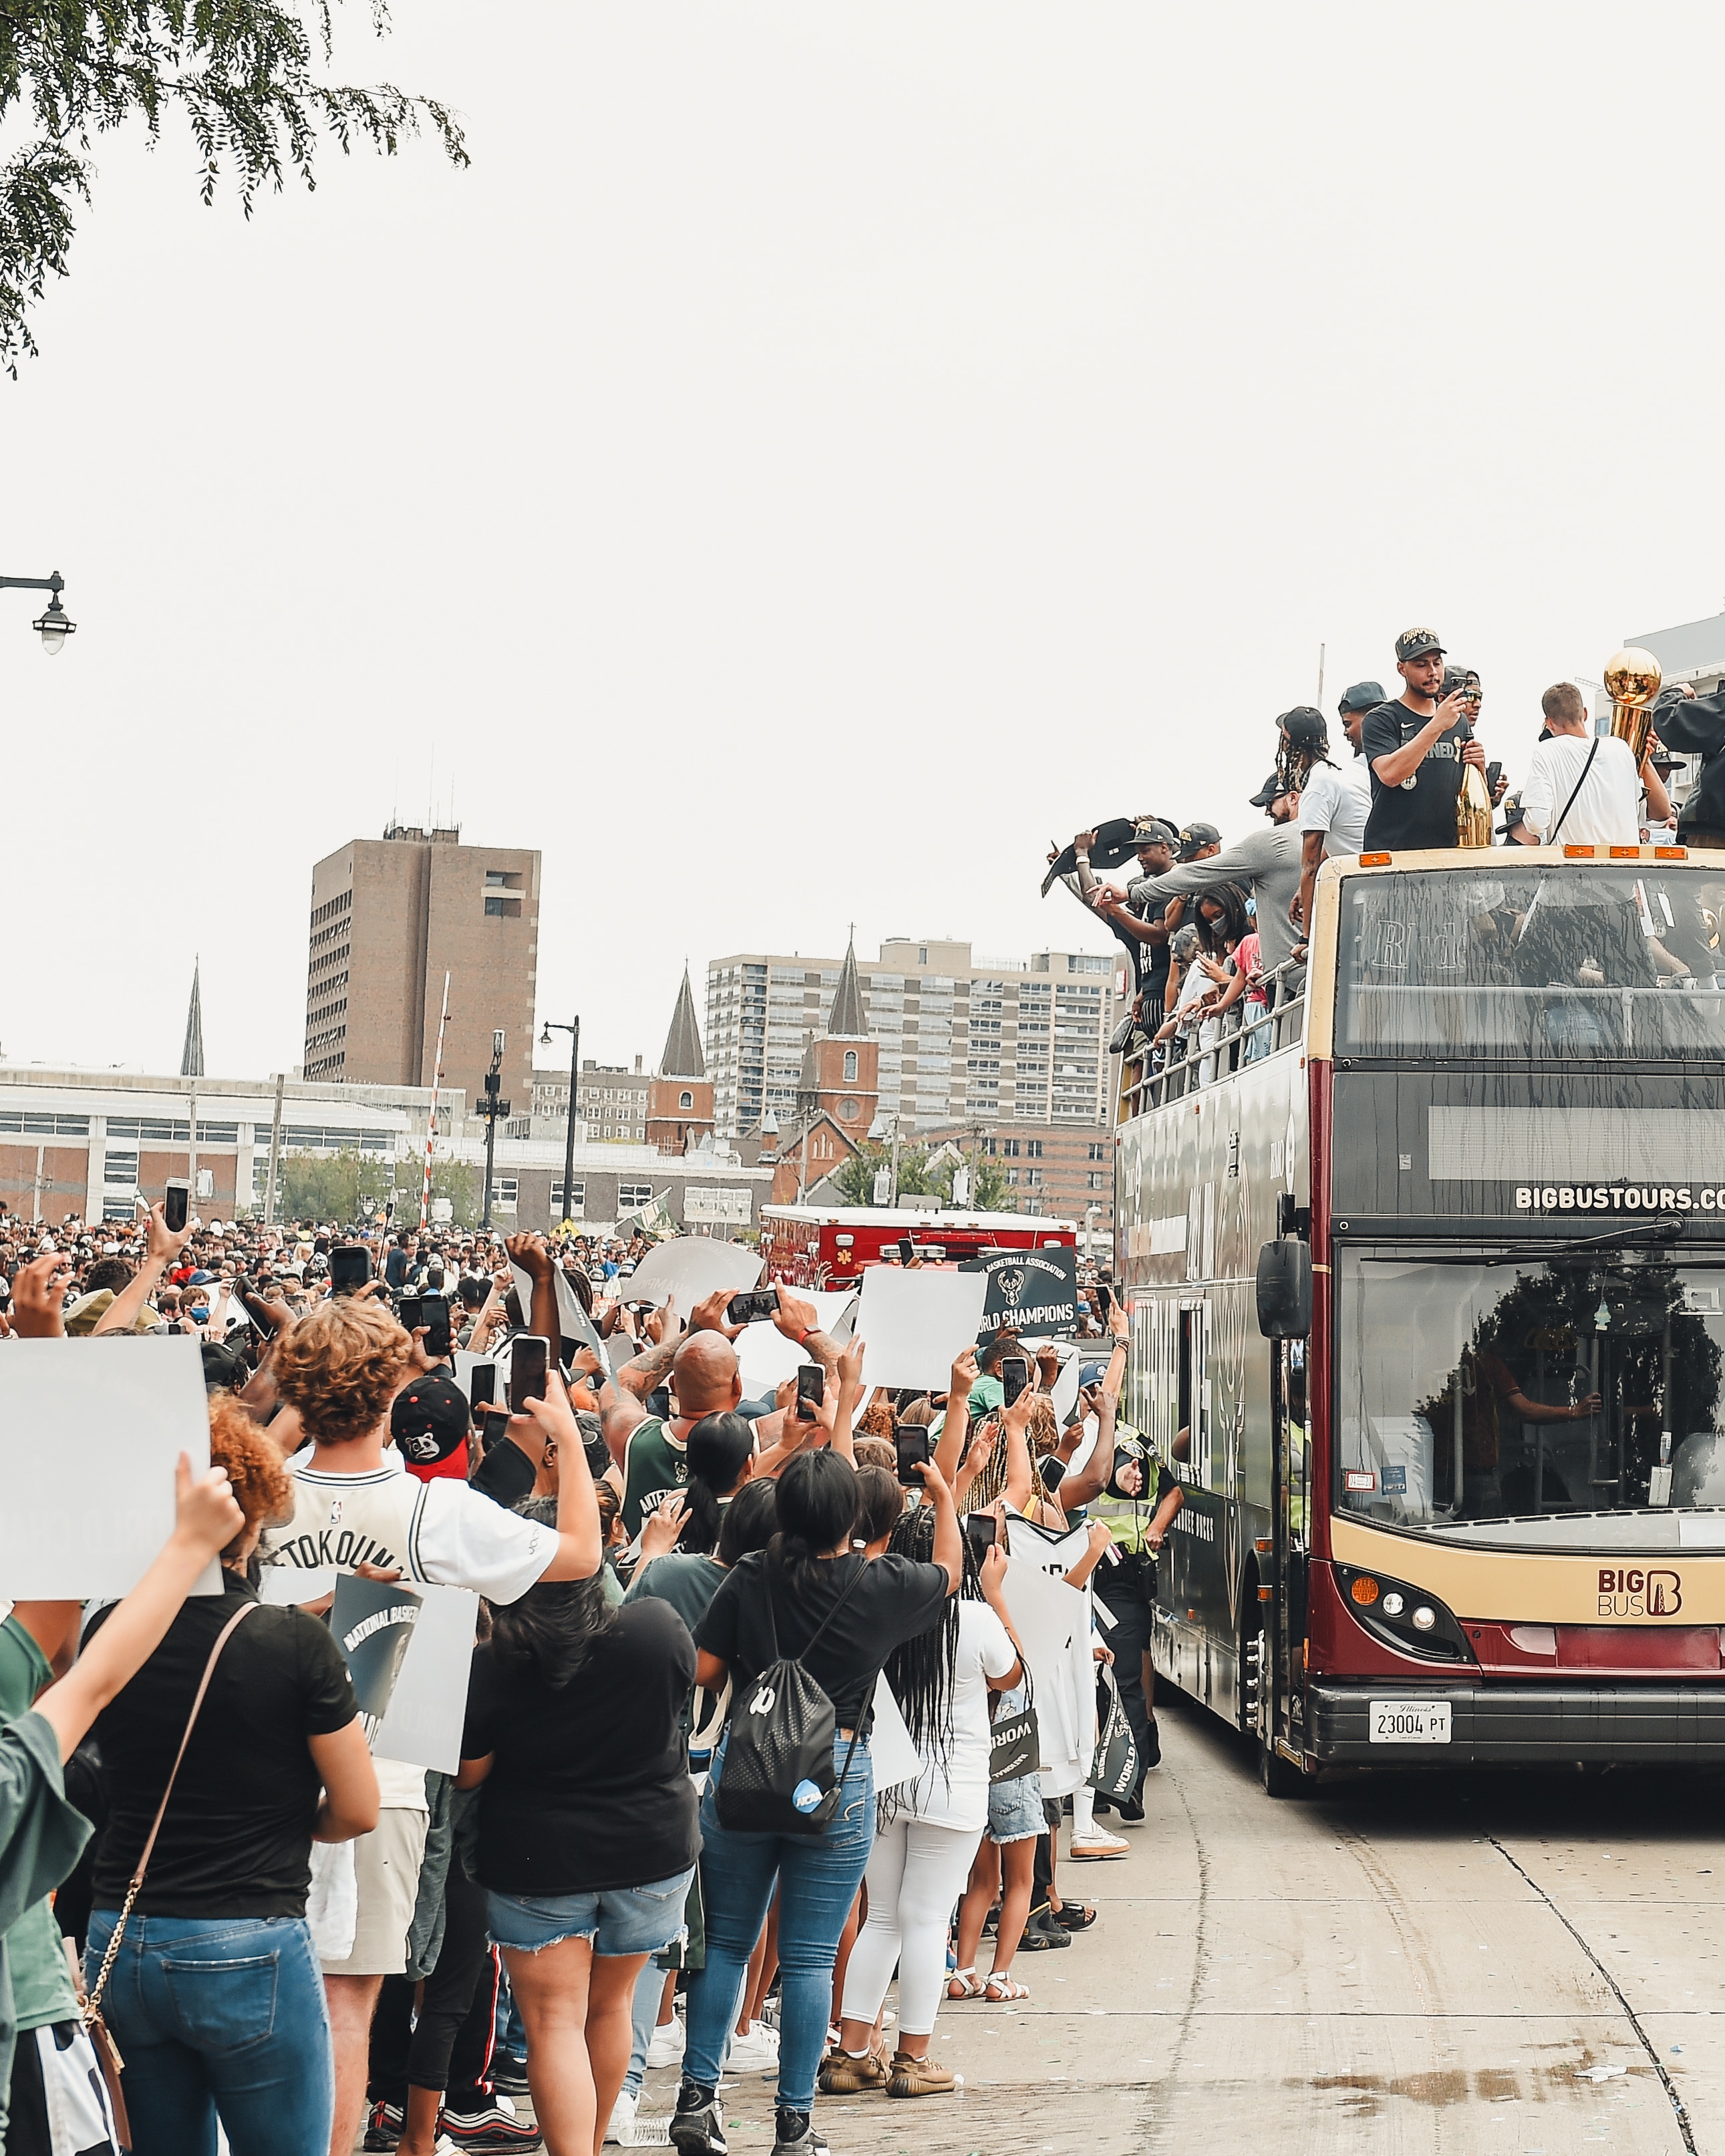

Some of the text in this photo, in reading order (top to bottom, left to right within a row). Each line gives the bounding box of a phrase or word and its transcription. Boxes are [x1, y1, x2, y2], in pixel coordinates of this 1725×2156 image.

[986, 1256, 1068, 1281] BASKETBALL ASSOCIATION
[1002, 1303, 1074, 1327] CHAMPIONS
[1599, 1569, 1644, 1593] BIG
[1598, 1595, 1644, 1617] BUS
[343, 1609, 391, 1653] NATIONAL
[1390, 1704, 1432, 1713] Illinois
[1103, 1703, 1117, 1748] BASKETBALL
[1378, 1714, 1446, 1734] 23004 PT
[992, 1753, 1030, 1778] NATIONAL
[1112, 1746, 1136, 1793] WORLD
